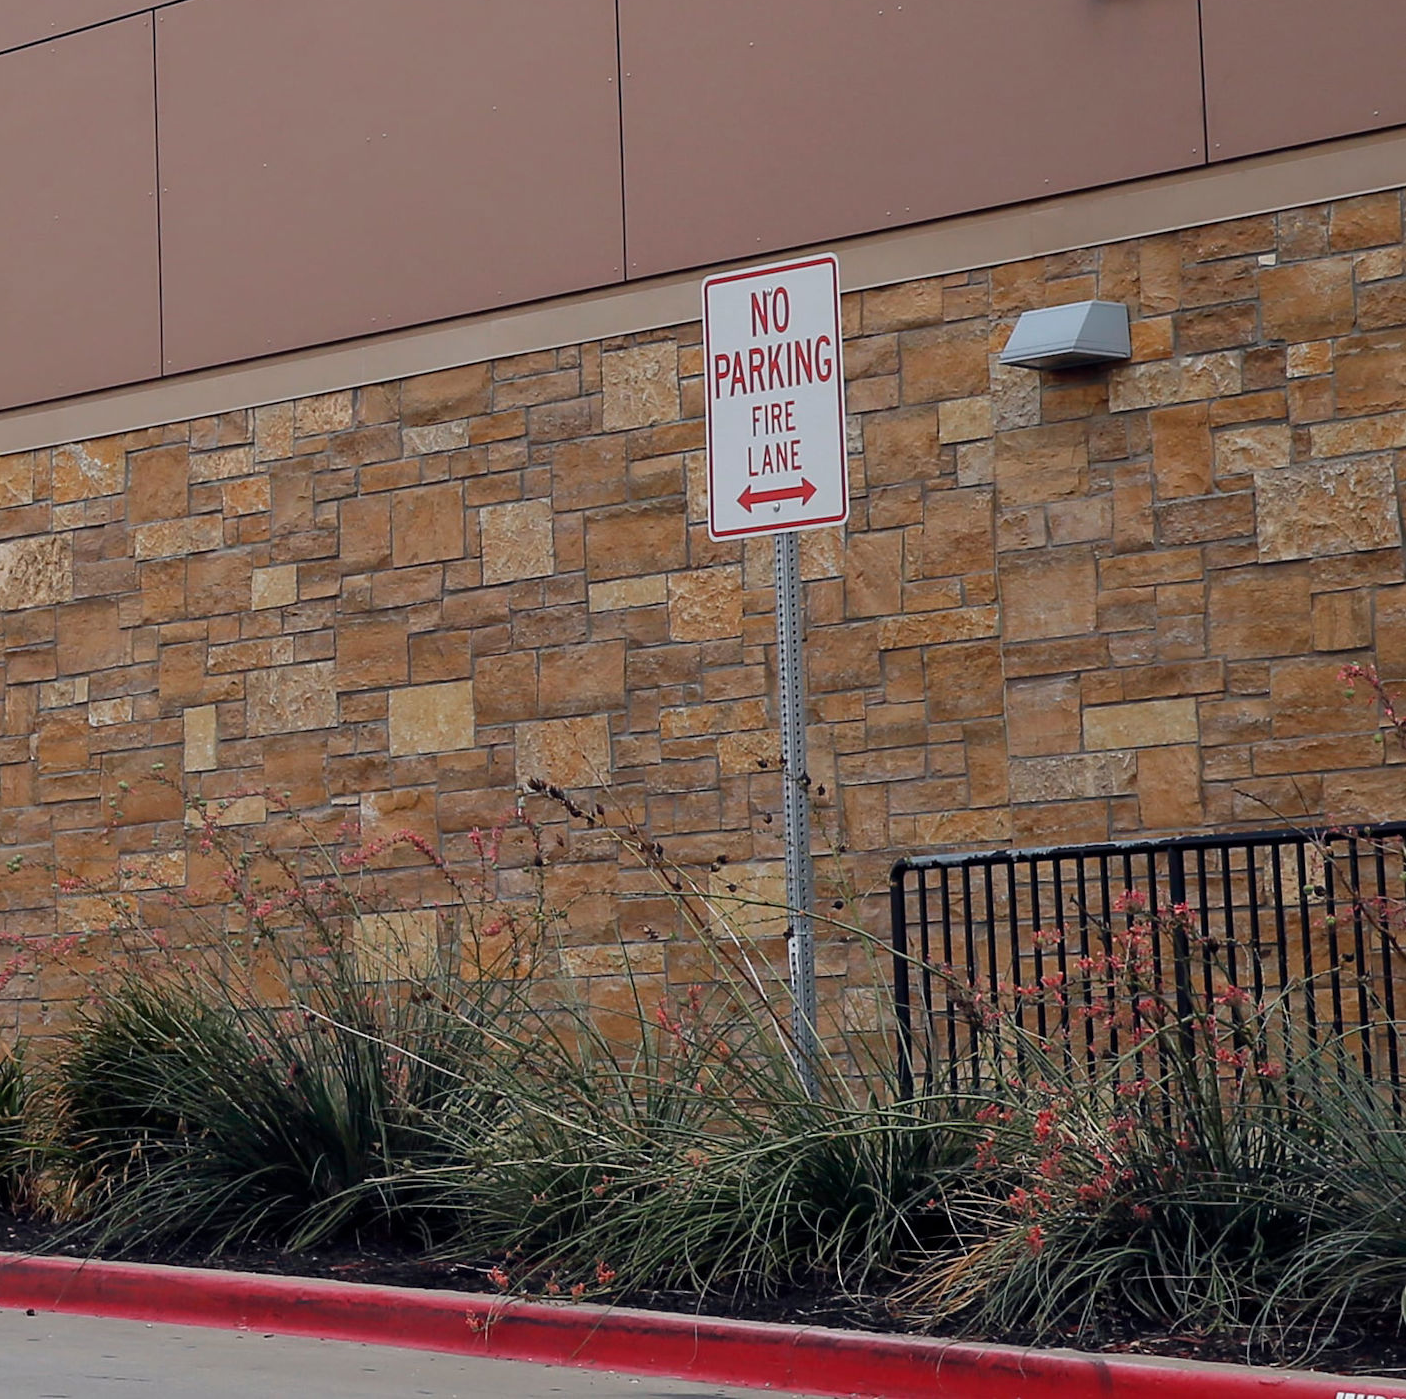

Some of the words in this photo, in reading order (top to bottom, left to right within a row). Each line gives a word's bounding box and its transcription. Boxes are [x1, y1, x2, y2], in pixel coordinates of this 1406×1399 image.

[750, 286, 790, 337] NO
[714, 335, 832, 399] PARKING
[752, 400, 796, 437] FIRE
[747, 440, 802, 477] LANE
